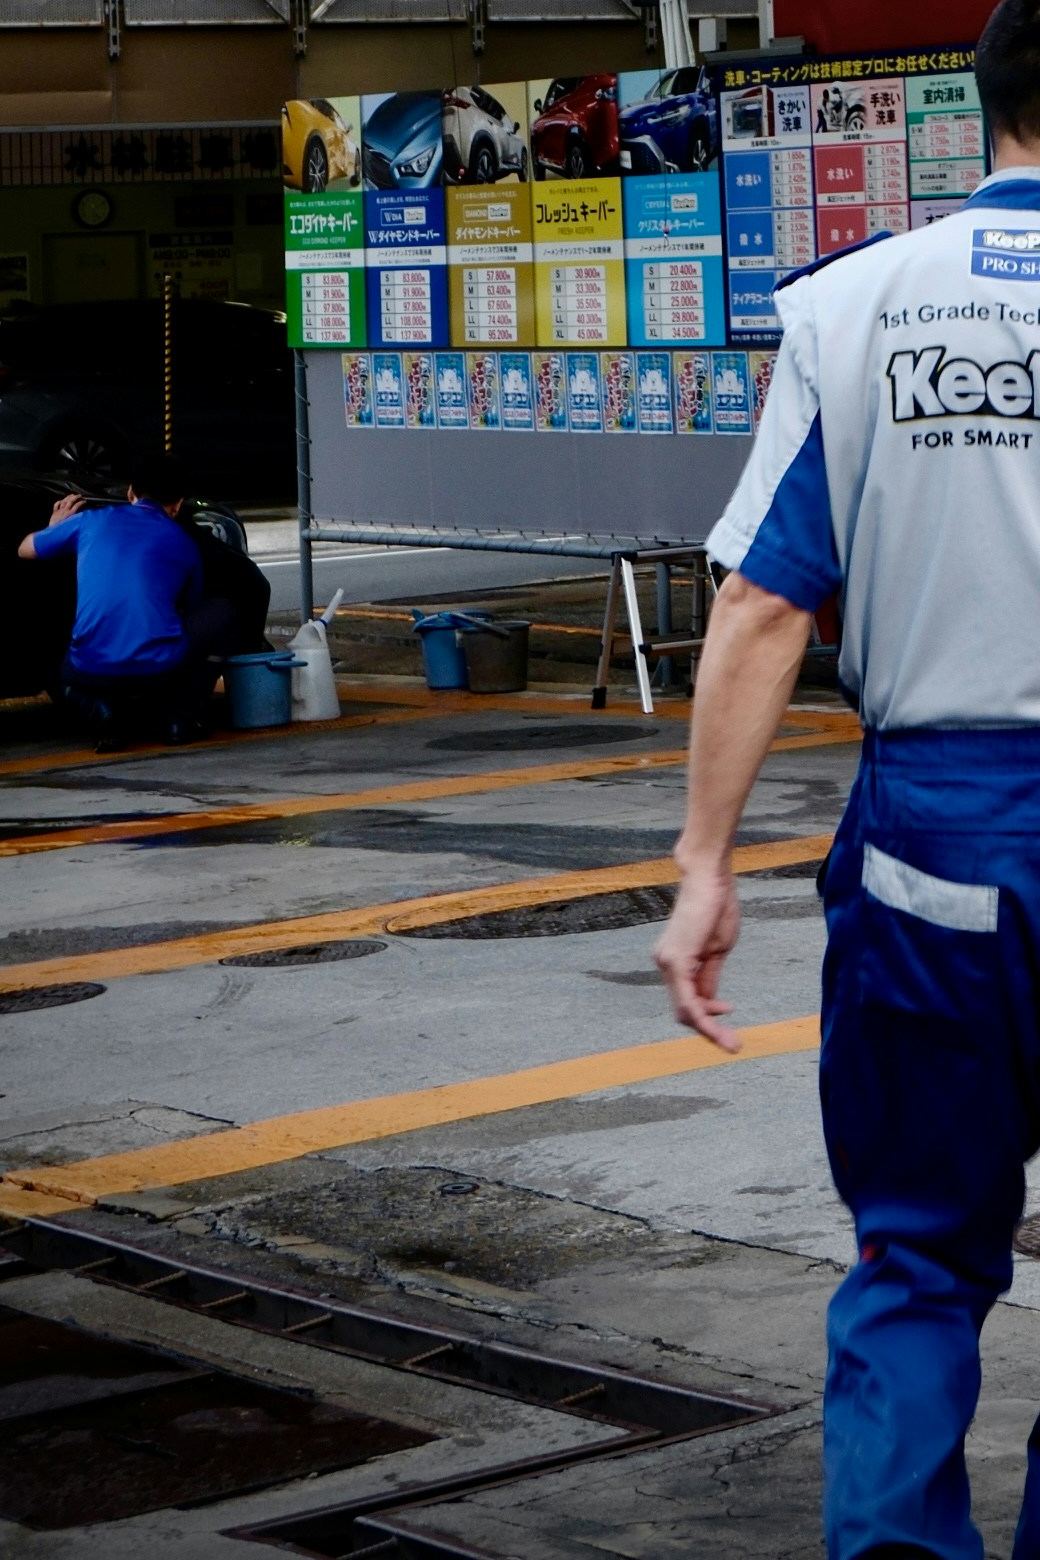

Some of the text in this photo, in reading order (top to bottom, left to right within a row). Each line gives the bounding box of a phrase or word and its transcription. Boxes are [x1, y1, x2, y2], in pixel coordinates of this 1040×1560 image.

[870, 91, 901, 108] 手洗い
[922, 86, 965, 105] 室内清掃
[778, 99, 806, 115] きかい
[875, 109, 896, 126] 洗車
[782, 116, 802, 132] 洗車
[982, 256, 1018, 273] PRO
[555, 269, 560, 279] S
[649, 266, 654, 275] S
[306, 276, 310, 284] S
[385, 274, 389, 282] S
[468, 272, 472, 280] S
[468, 286, 474, 294] M
[556, 285, 561, 293] M
[649, 282, 655, 290] M
[306, 290, 311, 298] M
[385, 288, 390, 296] M
[386, 302, 390, 311] L
[469, 300, 474, 310] L
[556, 299, 561, 309] L
[650, 297, 655, 307] L
[306, 303, 311, 312] L
[468, 316, 475, 324] LL
[556, 315, 563, 323] LL
[649, 313, 657, 322] LL
[879, 309, 909, 330] 1st
[917, 302, 990, 323] Grade
[306, 318, 312, 326] LL
[385, 317, 392, 325] LL
[306, 332, 313, 340] XL
[385, 331, 392, 339] XL
[469, 330, 476, 338] XL
[556, 329, 564, 338] XL
[649, 328, 658, 337] XL
[912, 432, 953, 450] FOR
[964, 430, 1033, 450] SMART
